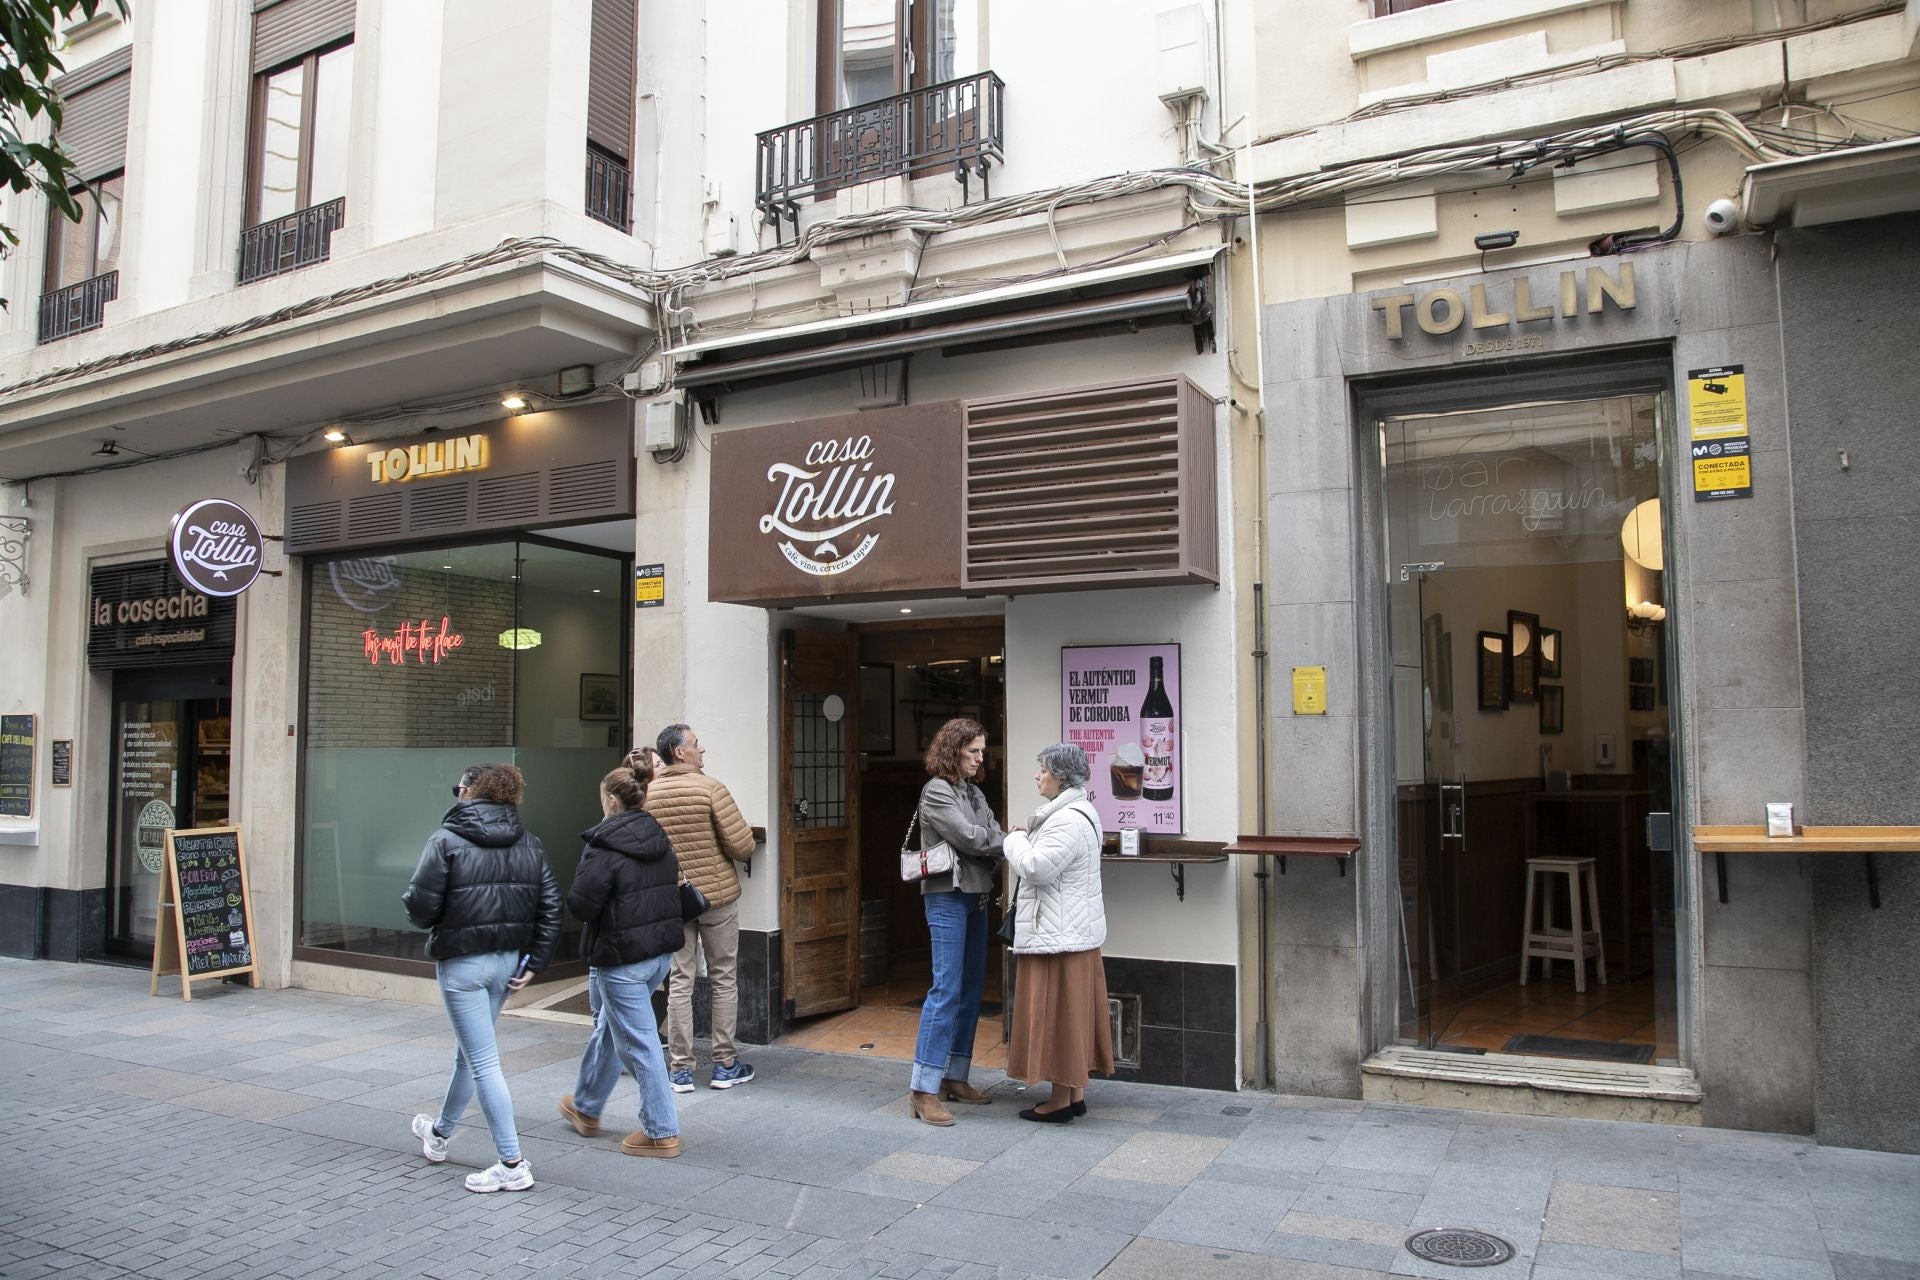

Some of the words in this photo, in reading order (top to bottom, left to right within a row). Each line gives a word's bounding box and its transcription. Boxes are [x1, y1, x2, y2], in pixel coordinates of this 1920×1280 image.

[1372, 262, 1637, 341] TOLLIN
[1463, 339, 1514, 357] DESDE
[367, 434, 482, 482] TOLLIN
[805, 435, 875, 465] casa
[1698, 461, 1745, 470] CONECTADA
[759, 462, 896, 542] Tollin
[210, 520, 247, 537] casa
[182, 525, 257, 571] Tollin
[853, 540, 871, 561] tapas
[94, 597, 112, 625] la
[117, 588, 208, 623] cosecha
[433, 616, 463, 663] place
[1069, 671, 1080, 687] EL
[1082, 667, 1136, 686] AUTÉNTICO
[1069, 688, 1109, 704] VERMUT
[1069, 707, 1082, 722] DE
[1084, 702, 1130, 722] CÓRDOBA
[1069, 729, 1082, 740] THE
[1083, 729, 1115, 740] AUTENTIC
